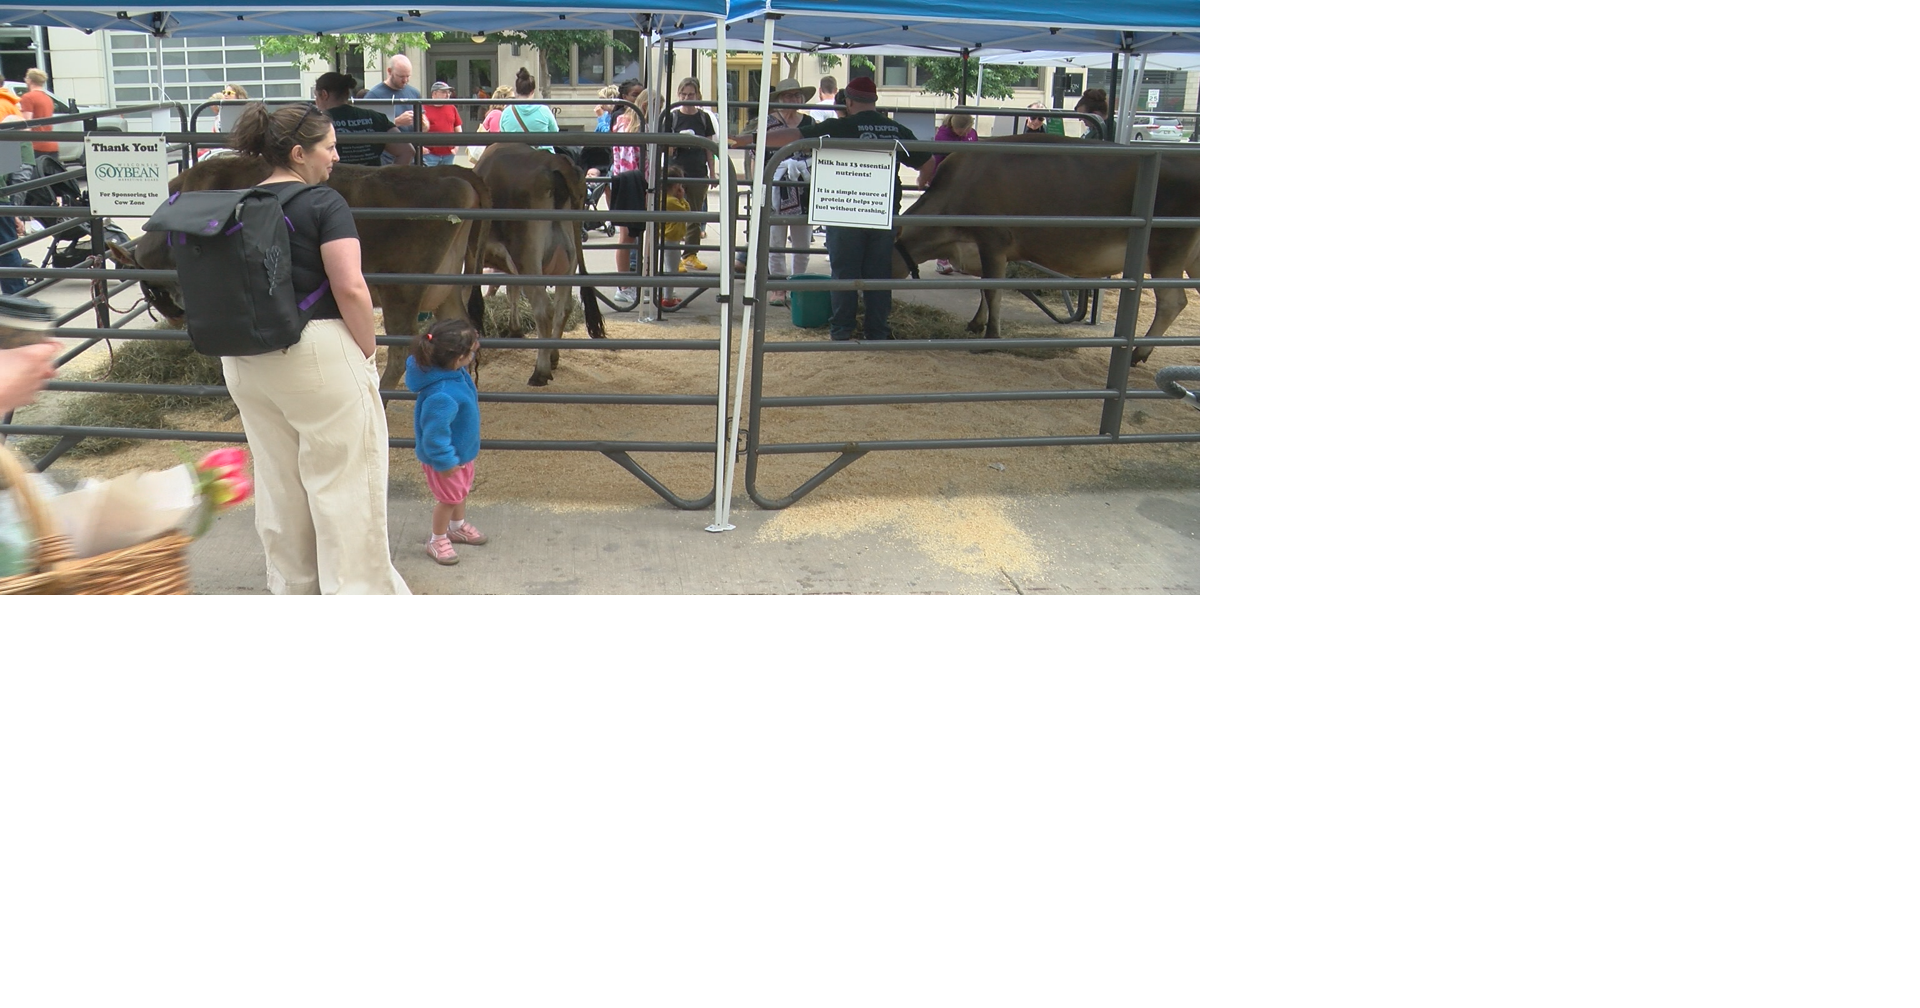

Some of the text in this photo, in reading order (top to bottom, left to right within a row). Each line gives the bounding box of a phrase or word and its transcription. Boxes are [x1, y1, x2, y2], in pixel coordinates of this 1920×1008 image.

[92, 143, 158, 152] Thank You!
[859, 162, 890, 170] essential
[98, 166, 160, 178] SOYBEAN
[836, 170, 872, 178] nutrients!
[111, 191, 147, 199] Sponsoring
